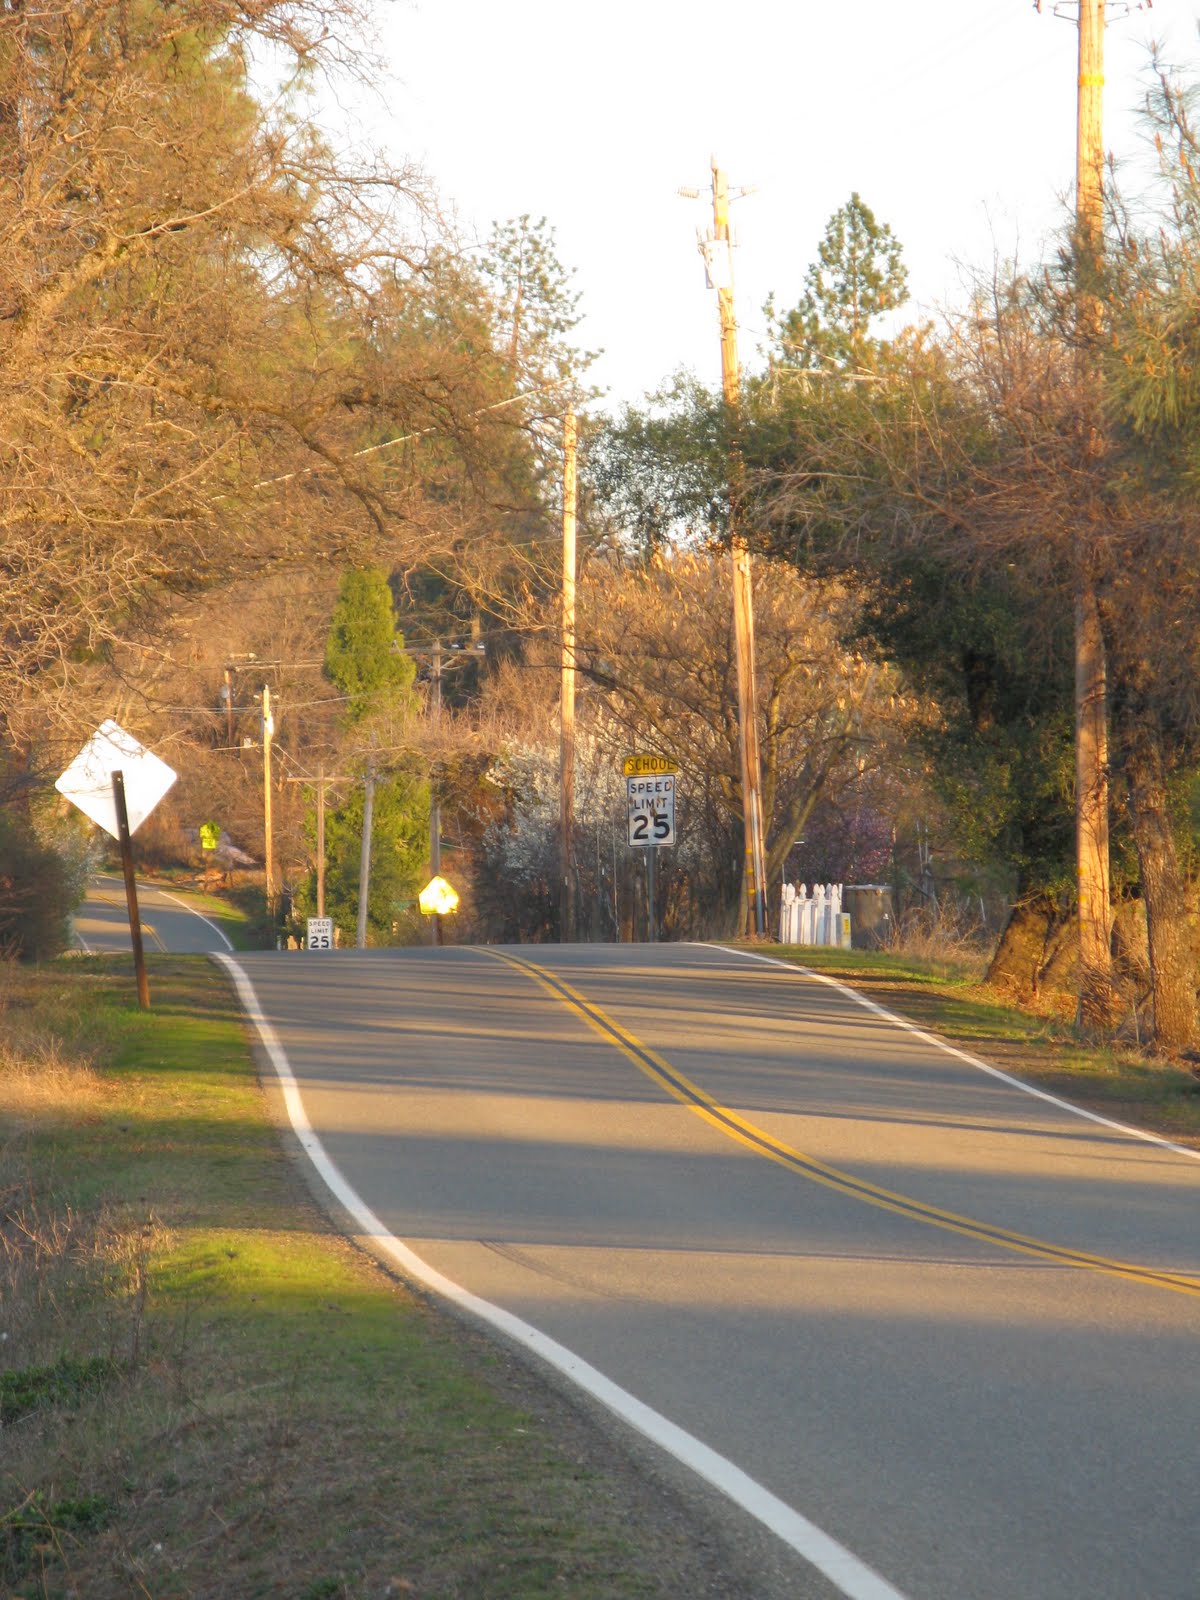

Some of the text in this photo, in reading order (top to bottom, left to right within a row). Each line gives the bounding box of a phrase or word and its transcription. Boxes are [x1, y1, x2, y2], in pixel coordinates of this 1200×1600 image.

[627, 759, 674, 771] SCHOOL
[630, 782, 672, 794] SPEED
[634, 798, 668, 810] LIMIT
[633, 814, 670, 840] 25
[310, 936, 329, 948] 25
